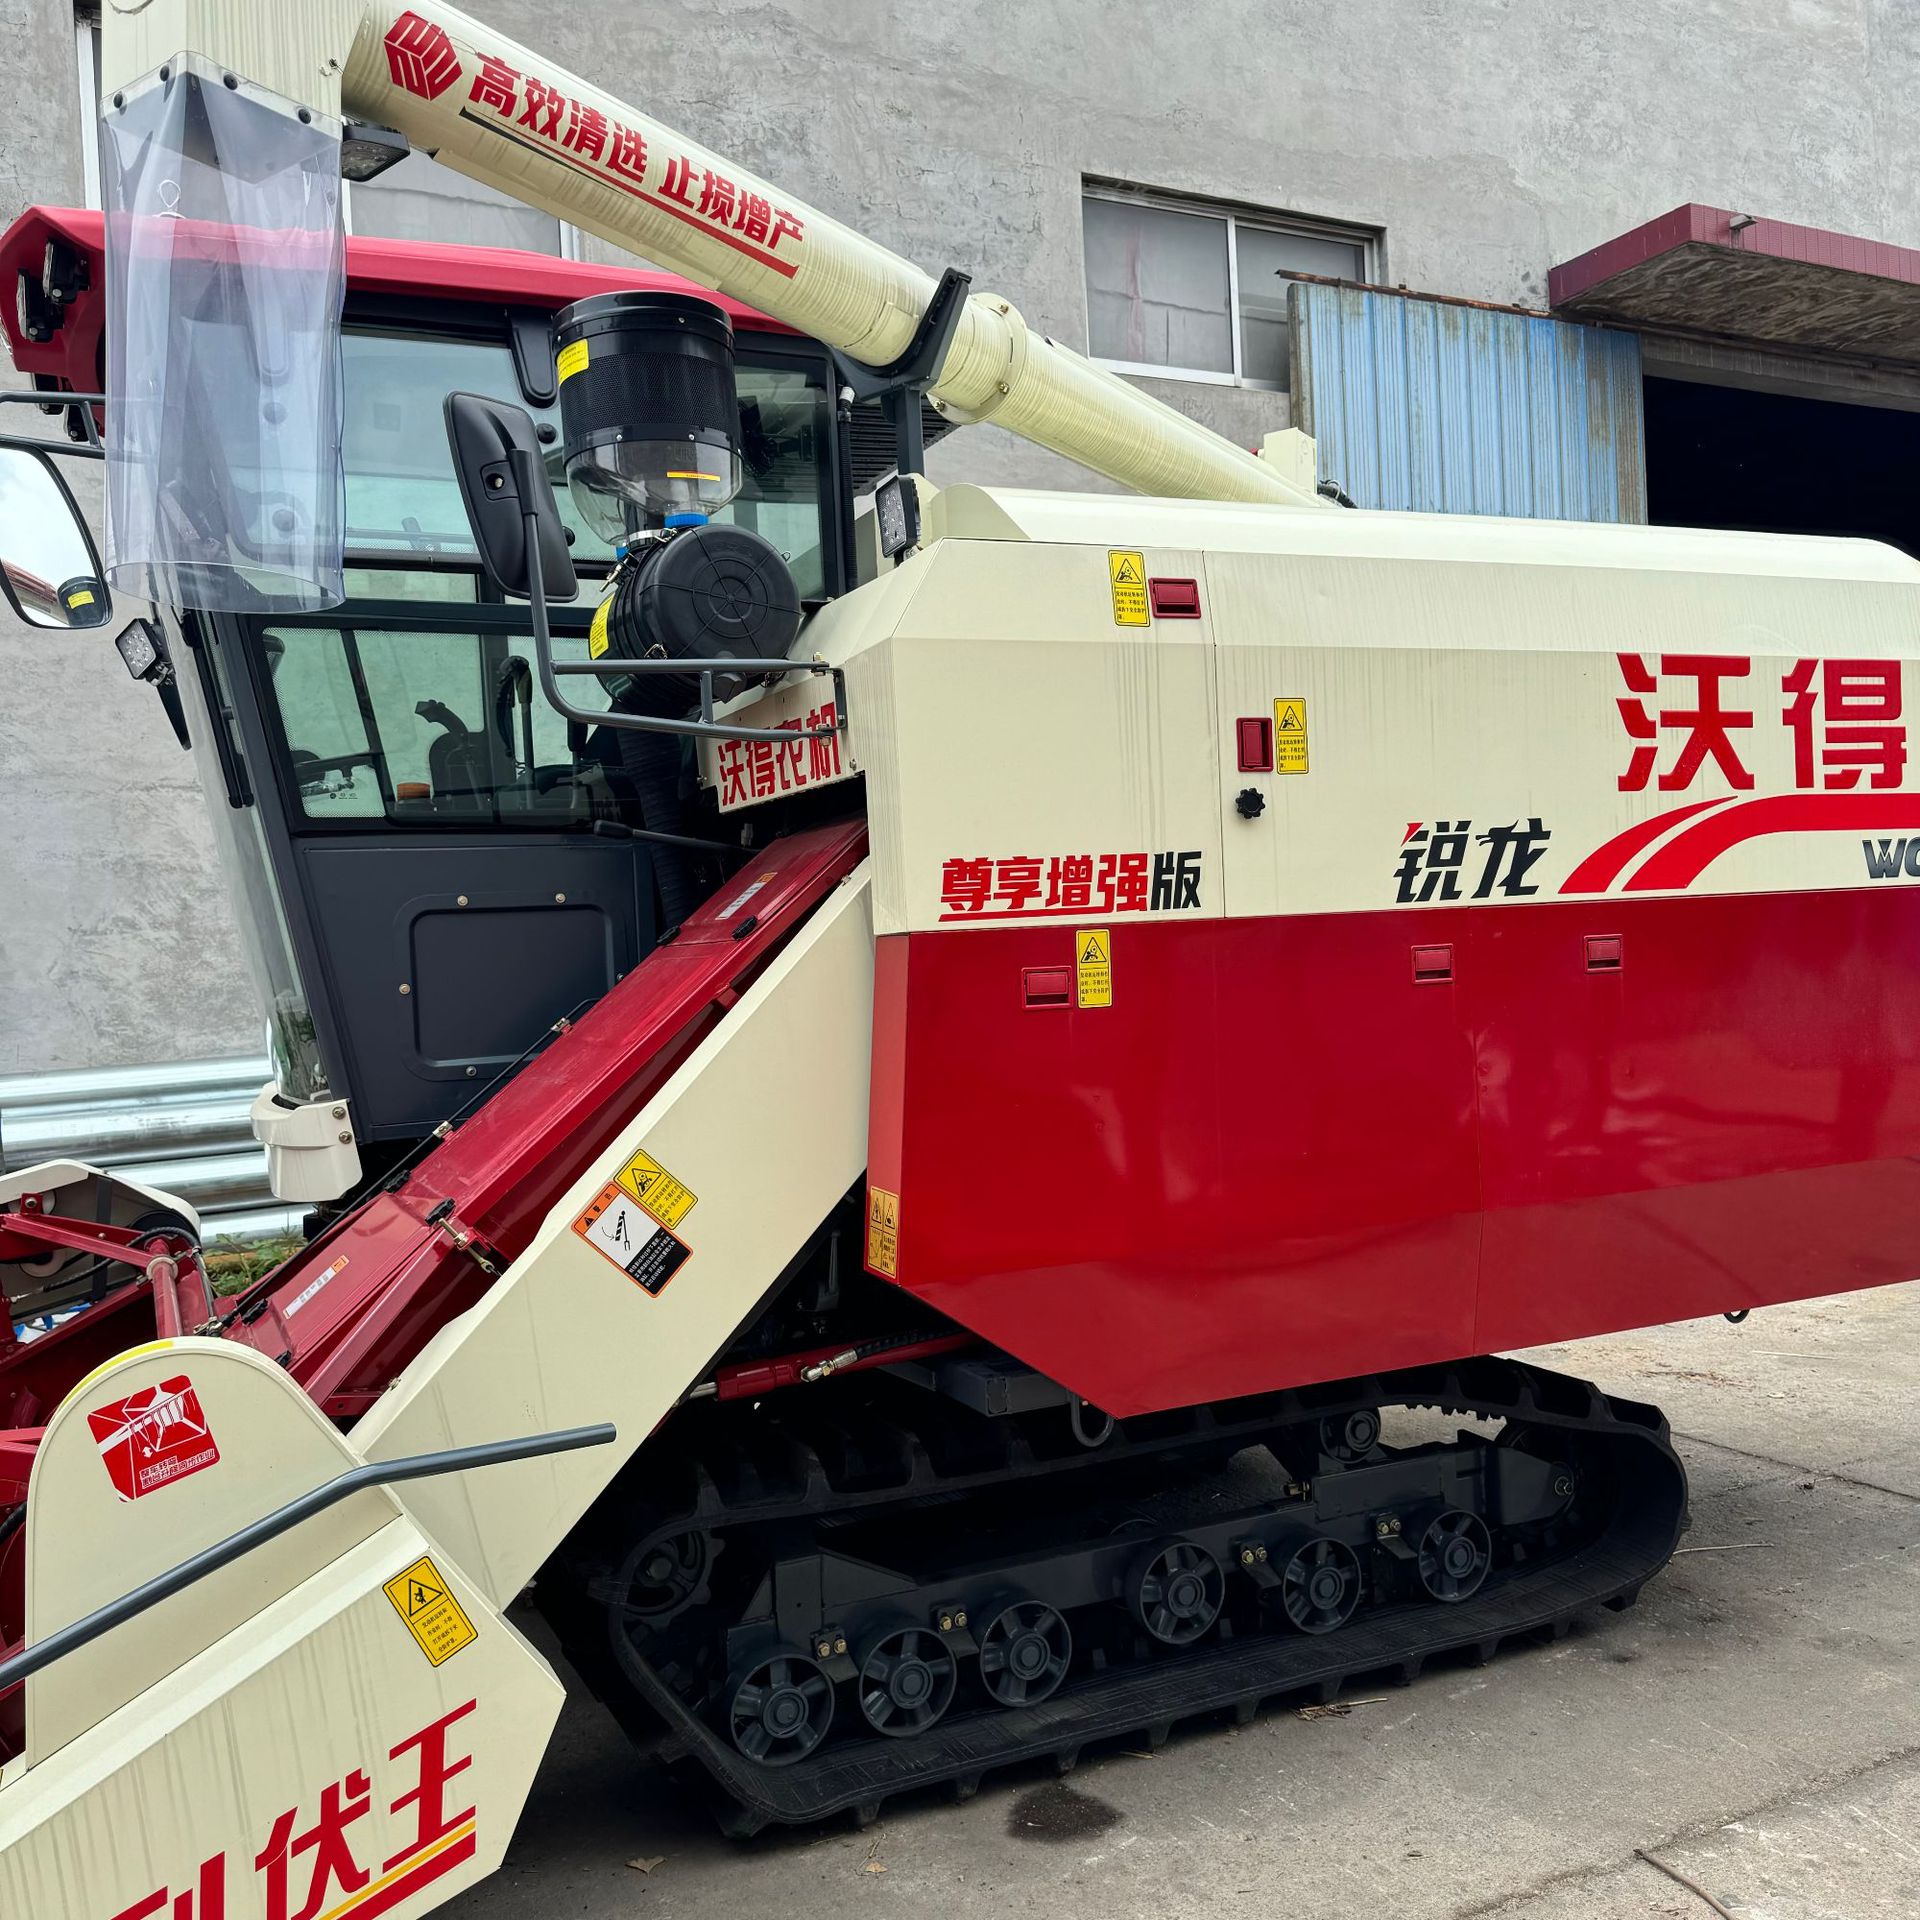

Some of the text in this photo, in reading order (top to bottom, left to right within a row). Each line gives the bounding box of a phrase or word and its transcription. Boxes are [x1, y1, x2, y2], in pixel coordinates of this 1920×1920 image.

[468, 51, 807, 251] 高效清选 止损增产
[1616, 653, 1907, 793] 沃得
[940, 851, 1203, 914] 尊享增强版
[1393, 818, 1552, 904] 锐龙
